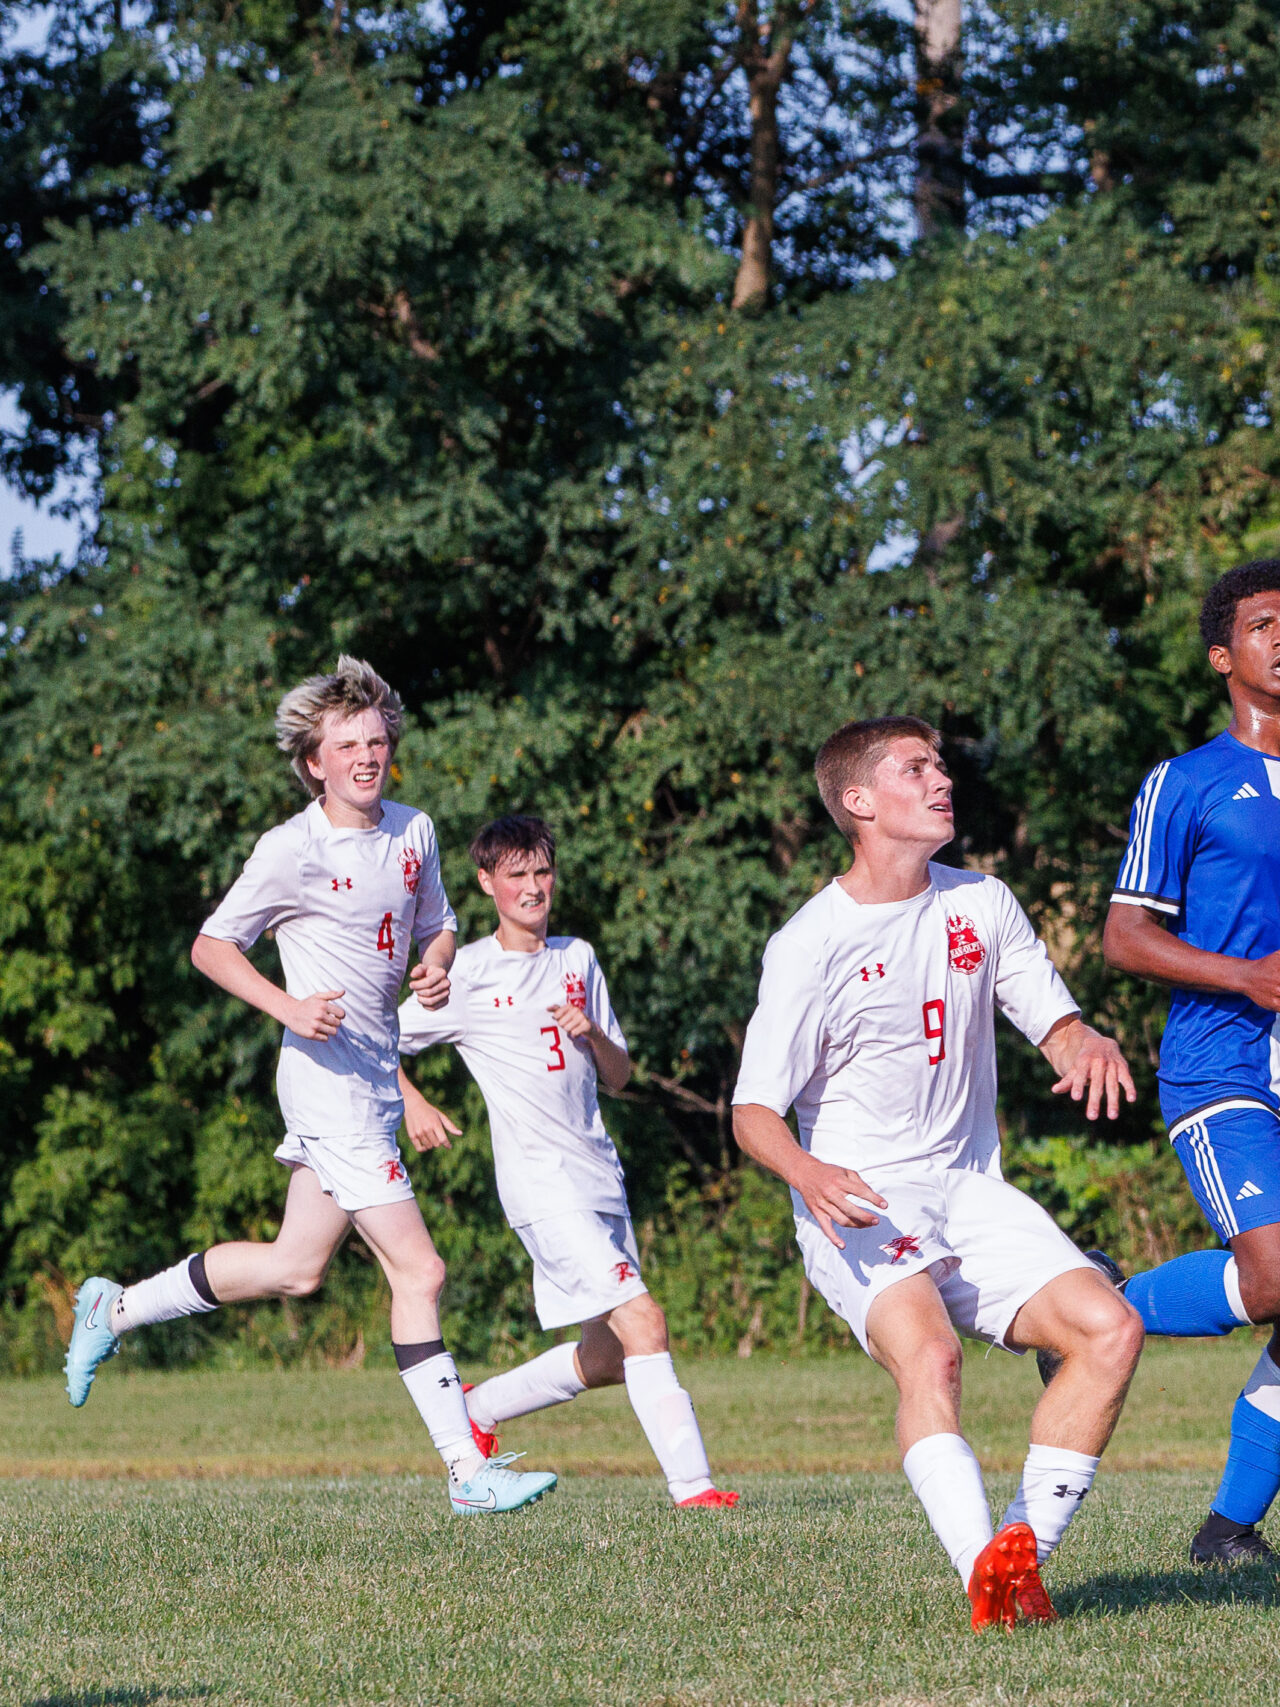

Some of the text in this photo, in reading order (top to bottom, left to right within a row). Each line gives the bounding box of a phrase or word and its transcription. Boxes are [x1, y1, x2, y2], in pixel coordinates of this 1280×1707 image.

[376, 912, 395, 960] 4
[540, 1026, 566, 1072] 3
[922, 999, 946, 1065] 9
